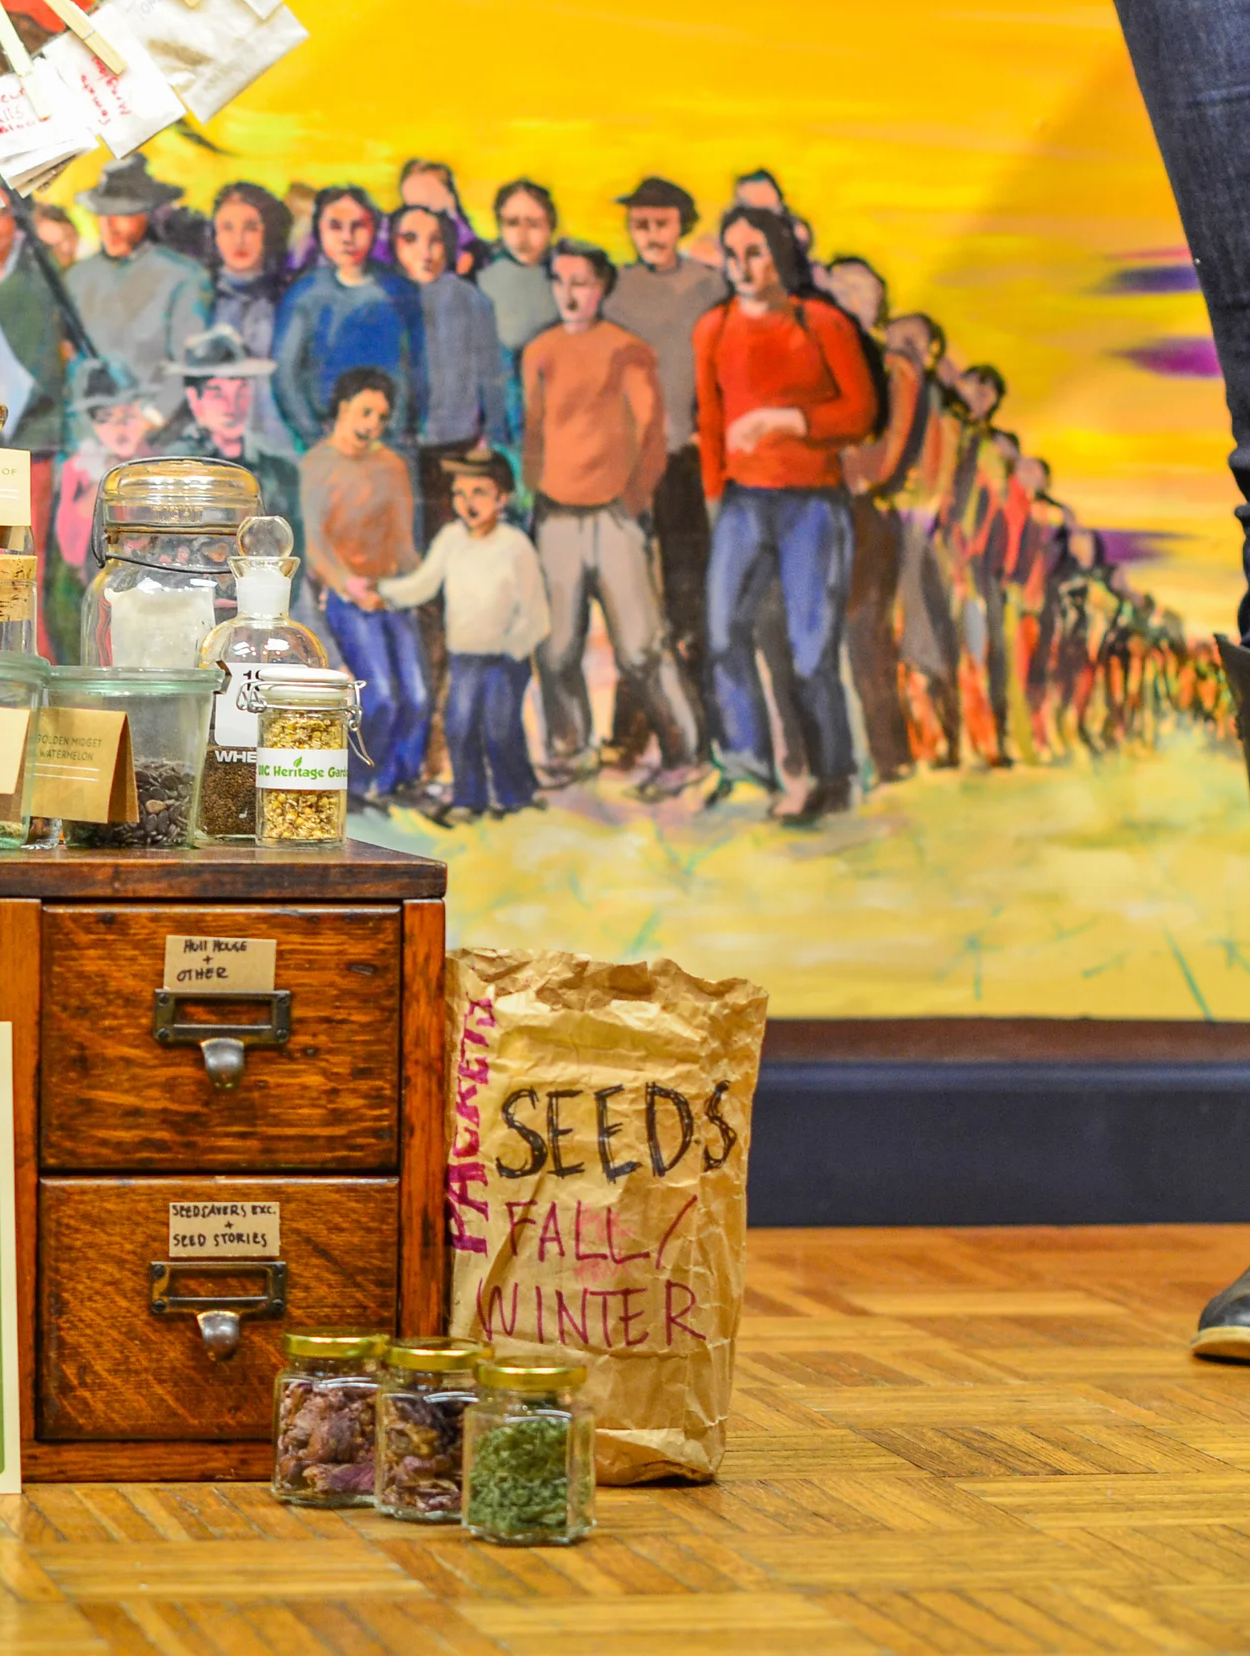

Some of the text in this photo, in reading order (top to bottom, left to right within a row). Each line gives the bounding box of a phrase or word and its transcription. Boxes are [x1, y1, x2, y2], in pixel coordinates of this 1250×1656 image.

[2, 467, 17, 476] OF
[71, 736, 102, 748] MIDGET
[38, 750, 94, 761] WATERMELON
[273, 766, 325, 780] Heritage
[176, 967, 228, 982] OTHER
[446, 992, 496, 1256] PACKETS
[495, 1080, 737, 1184] SEEDS
[173, 1232, 268, 1248] SEED STORIES
[476, 1278, 706, 1348] WINTER
